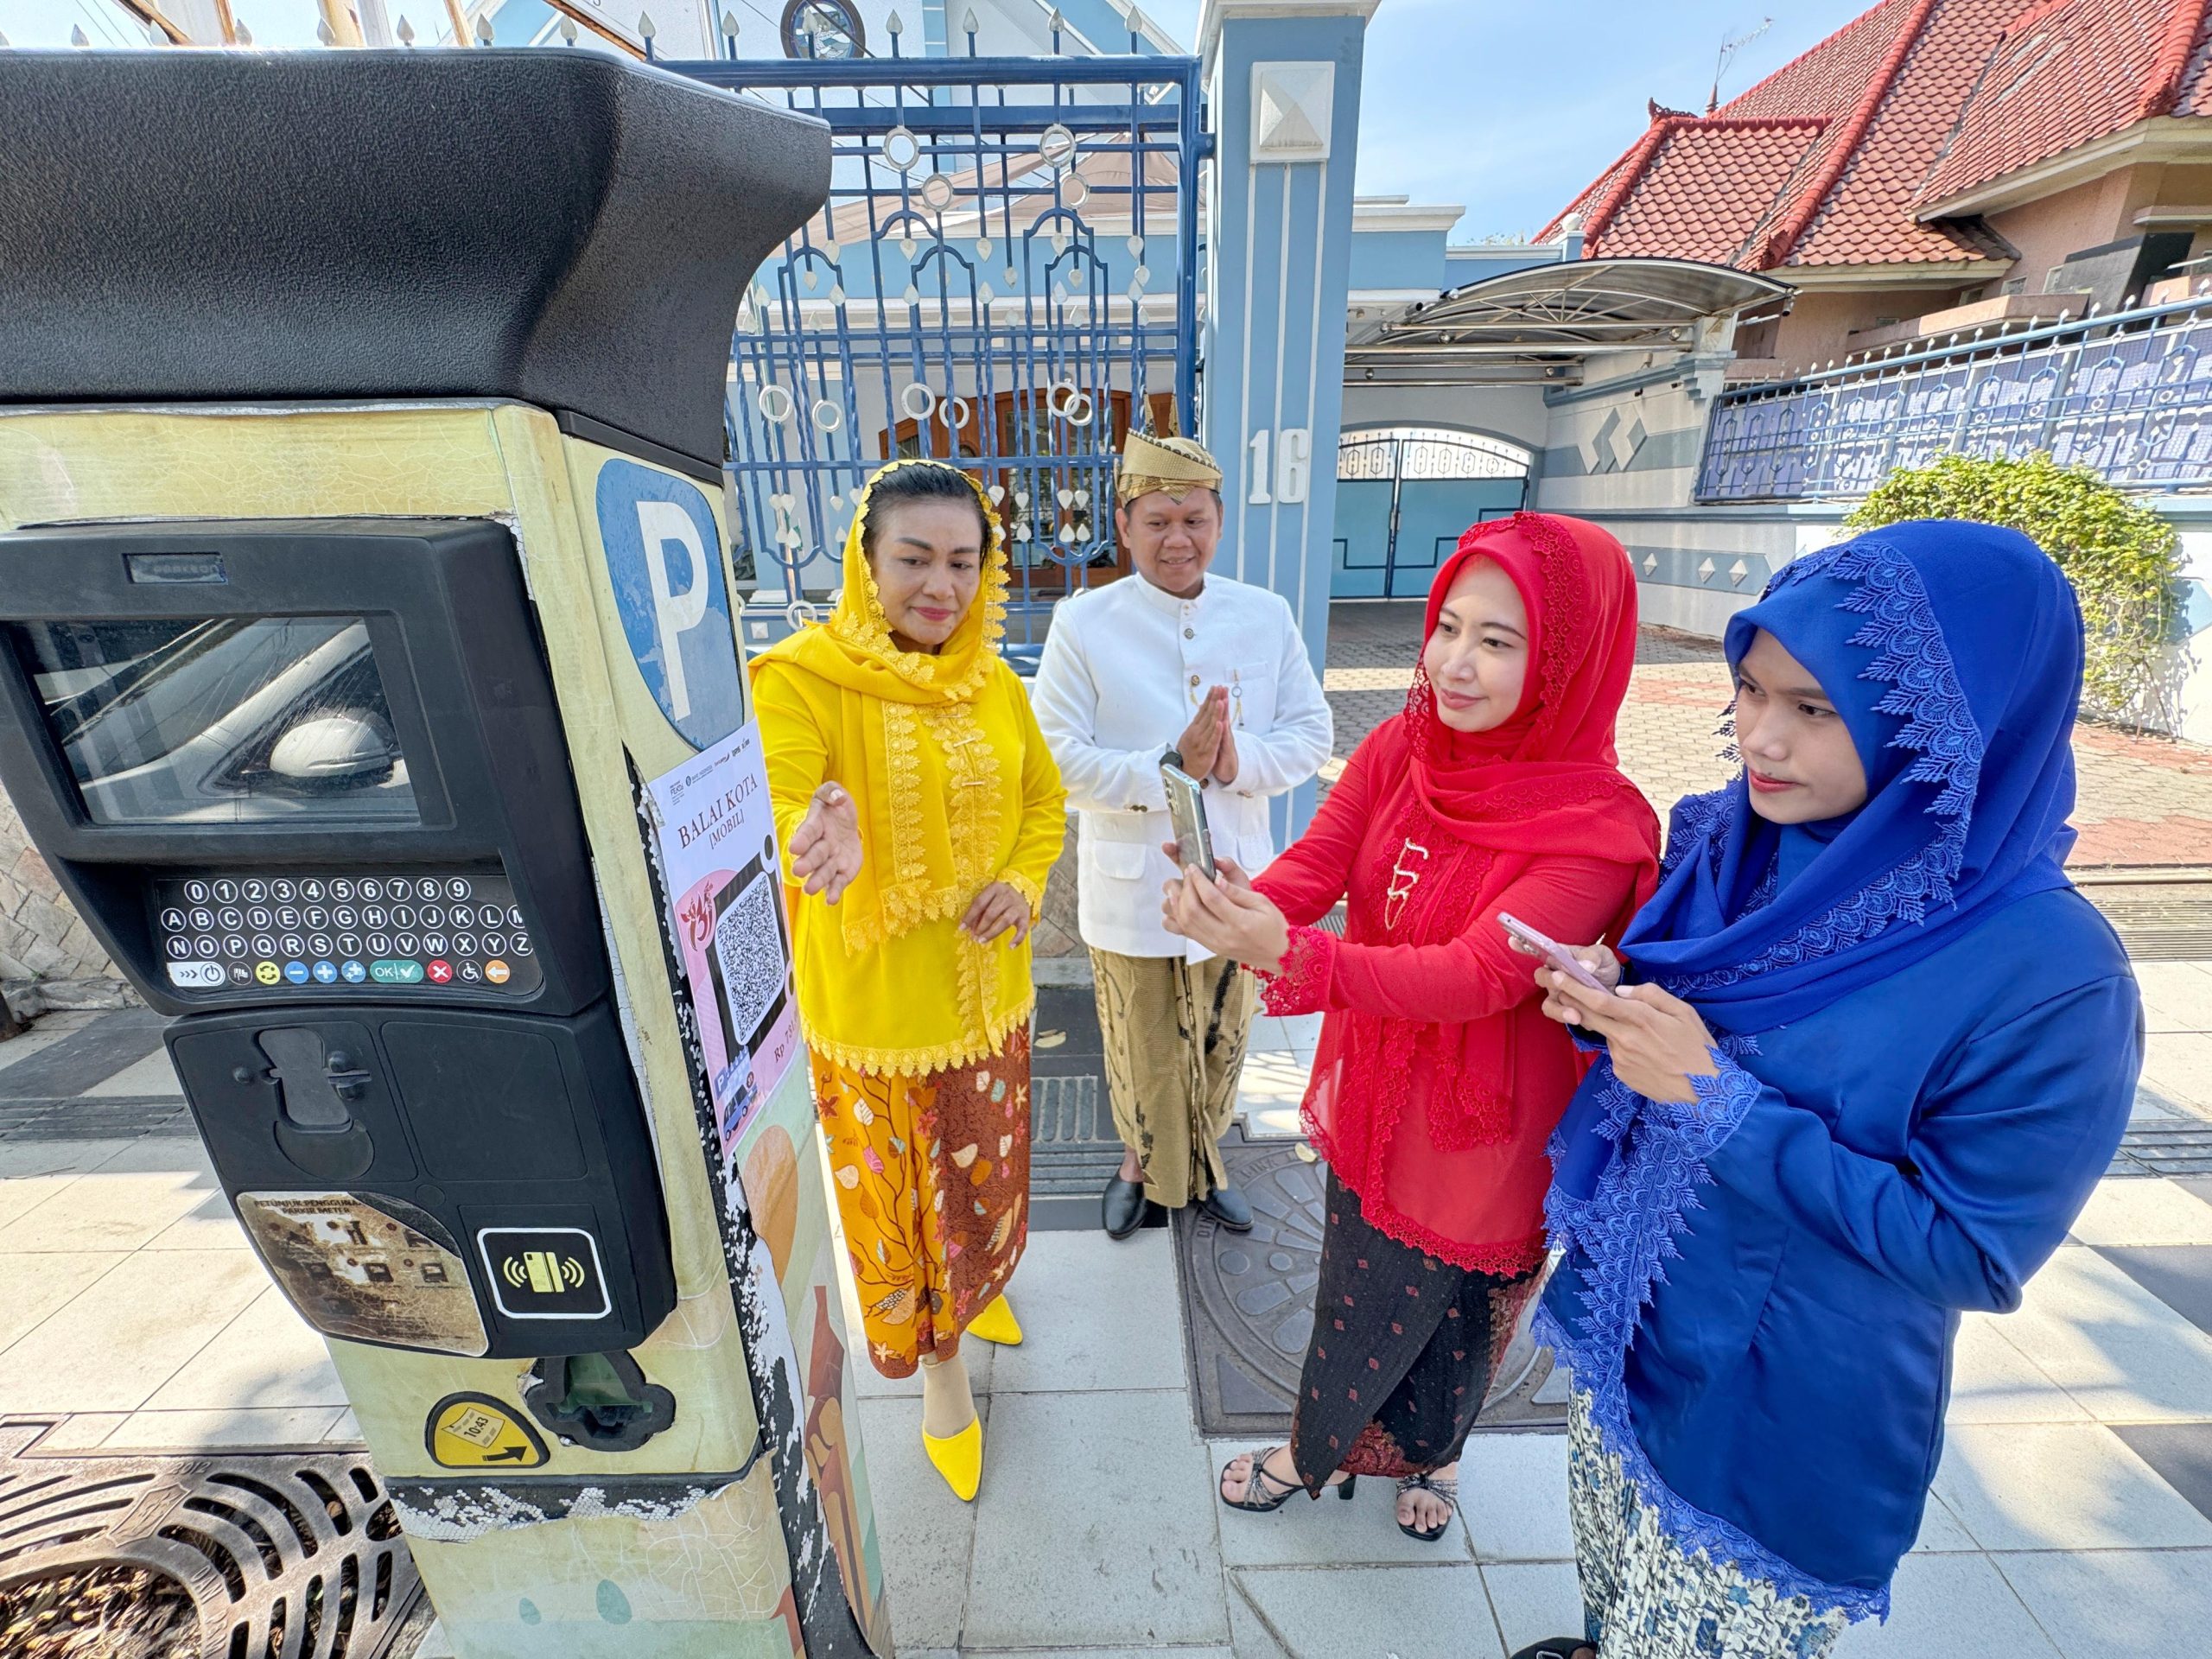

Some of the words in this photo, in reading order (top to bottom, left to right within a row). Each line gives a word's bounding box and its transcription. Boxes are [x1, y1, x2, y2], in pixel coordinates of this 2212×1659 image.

[1249, 429, 1309, 504] 16
[636, 501, 709, 721] P
[677, 798, 723, 849] BALAI
[725, 773, 758, 811] KOTA
[191, 884, 203, 899] 0
[219, 883, 230, 899] 1
[249, 883, 262, 899] 2
[277, 882, 290, 898] 3
[307, 882, 319, 898] 4
[337, 882, 348, 898] 5
[364, 882, 376, 897] 6
[393, 882, 404, 897] 7
[423, 881, 435, 897] 8
[453, 881, 464, 897] 9
[168, 912, 181, 925] A
[195, 912, 209, 925] B
[224, 911, 238, 925] C
[253, 911, 267, 925] D
[282, 911, 295, 925] E
[310, 911, 321, 925] F
[338, 910, 352, 924] G
[368, 910, 382, 924] H
[427, 910, 437, 924] J
[455, 910, 469, 924] K
[486, 910, 498, 924] L
[173, 940, 187, 954] N
[200, 940, 213, 954] O
[229, 939, 242, 953] P
[257, 939, 272, 954] Q
[286, 938, 301, 952] R
[315, 938, 327, 952] S
[342, 938, 354, 951] T
[372, 938, 385, 951] U
[400, 938, 413, 951] V
[426, 938, 443, 951] W
[458, 938, 472, 951] X
[487, 938, 500, 951] Y
[517, 938, 529, 951] Z
[375, 967, 392, 977] OK
[774, 1044, 785, 1063] Rp
[317, 1206, 350, 1215] METER
[464, 1416, 488, 1438] 10:43
[166, 1461, 213, 1475] 2012
